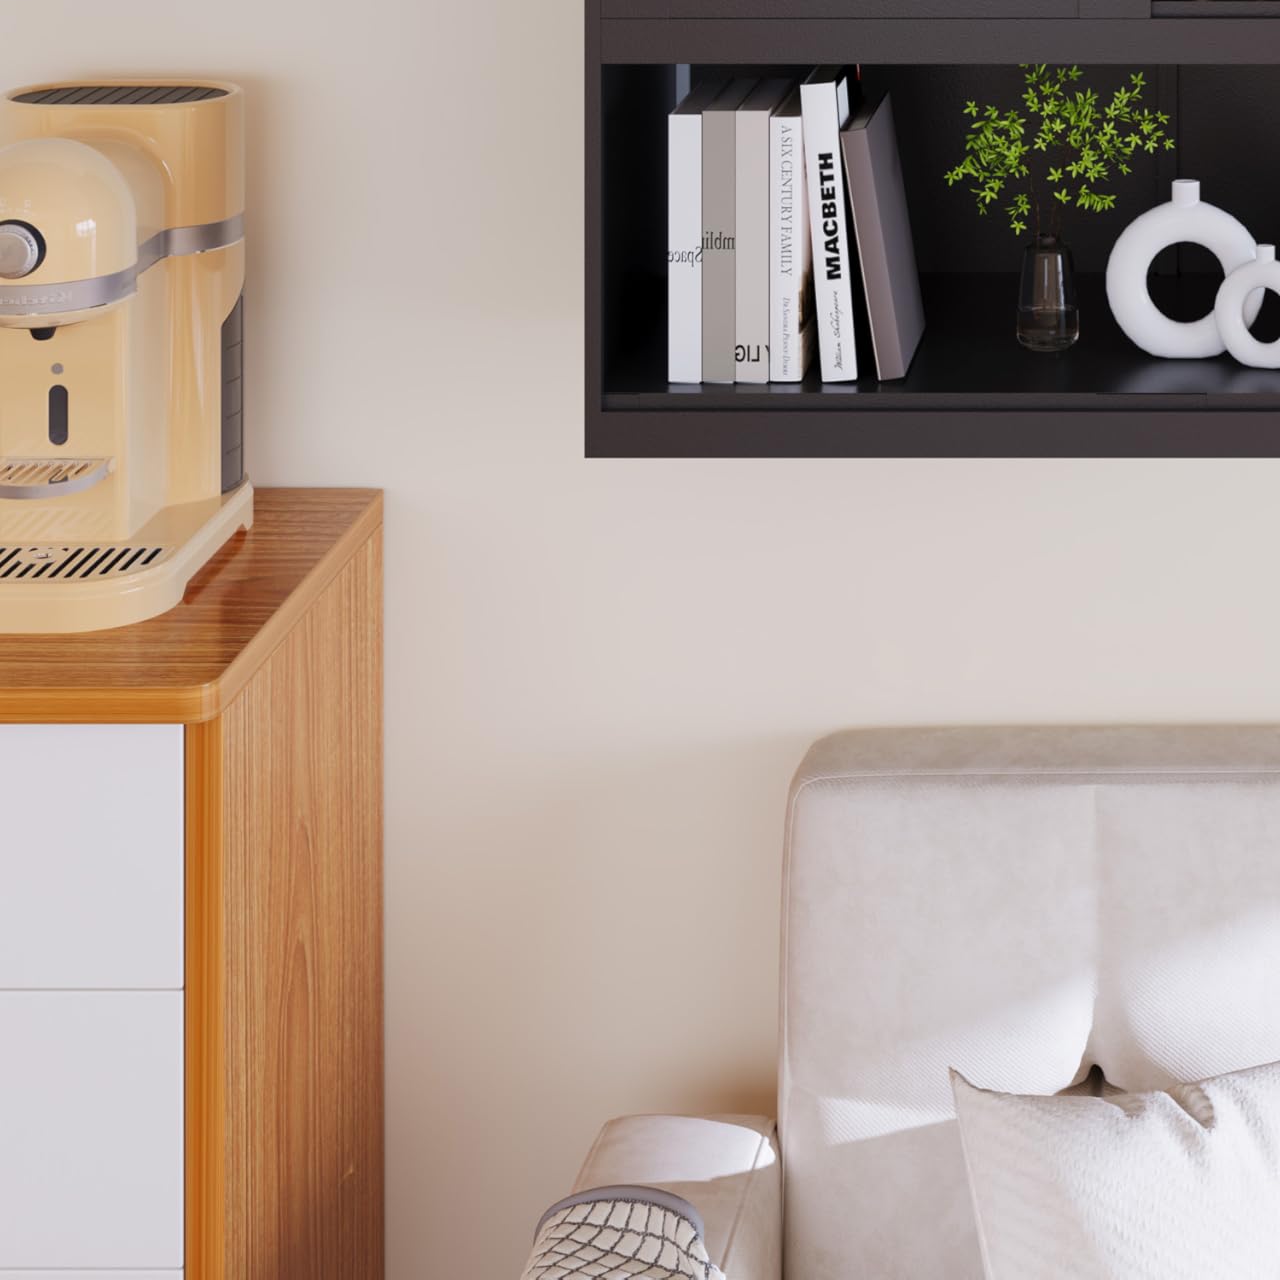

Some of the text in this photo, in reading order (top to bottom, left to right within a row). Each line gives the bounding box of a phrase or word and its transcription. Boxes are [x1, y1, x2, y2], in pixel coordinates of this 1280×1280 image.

[780, 125, 792, 276] A SIX CENTURY FAMILY
[818, 152, 842, 280] MACBETH
